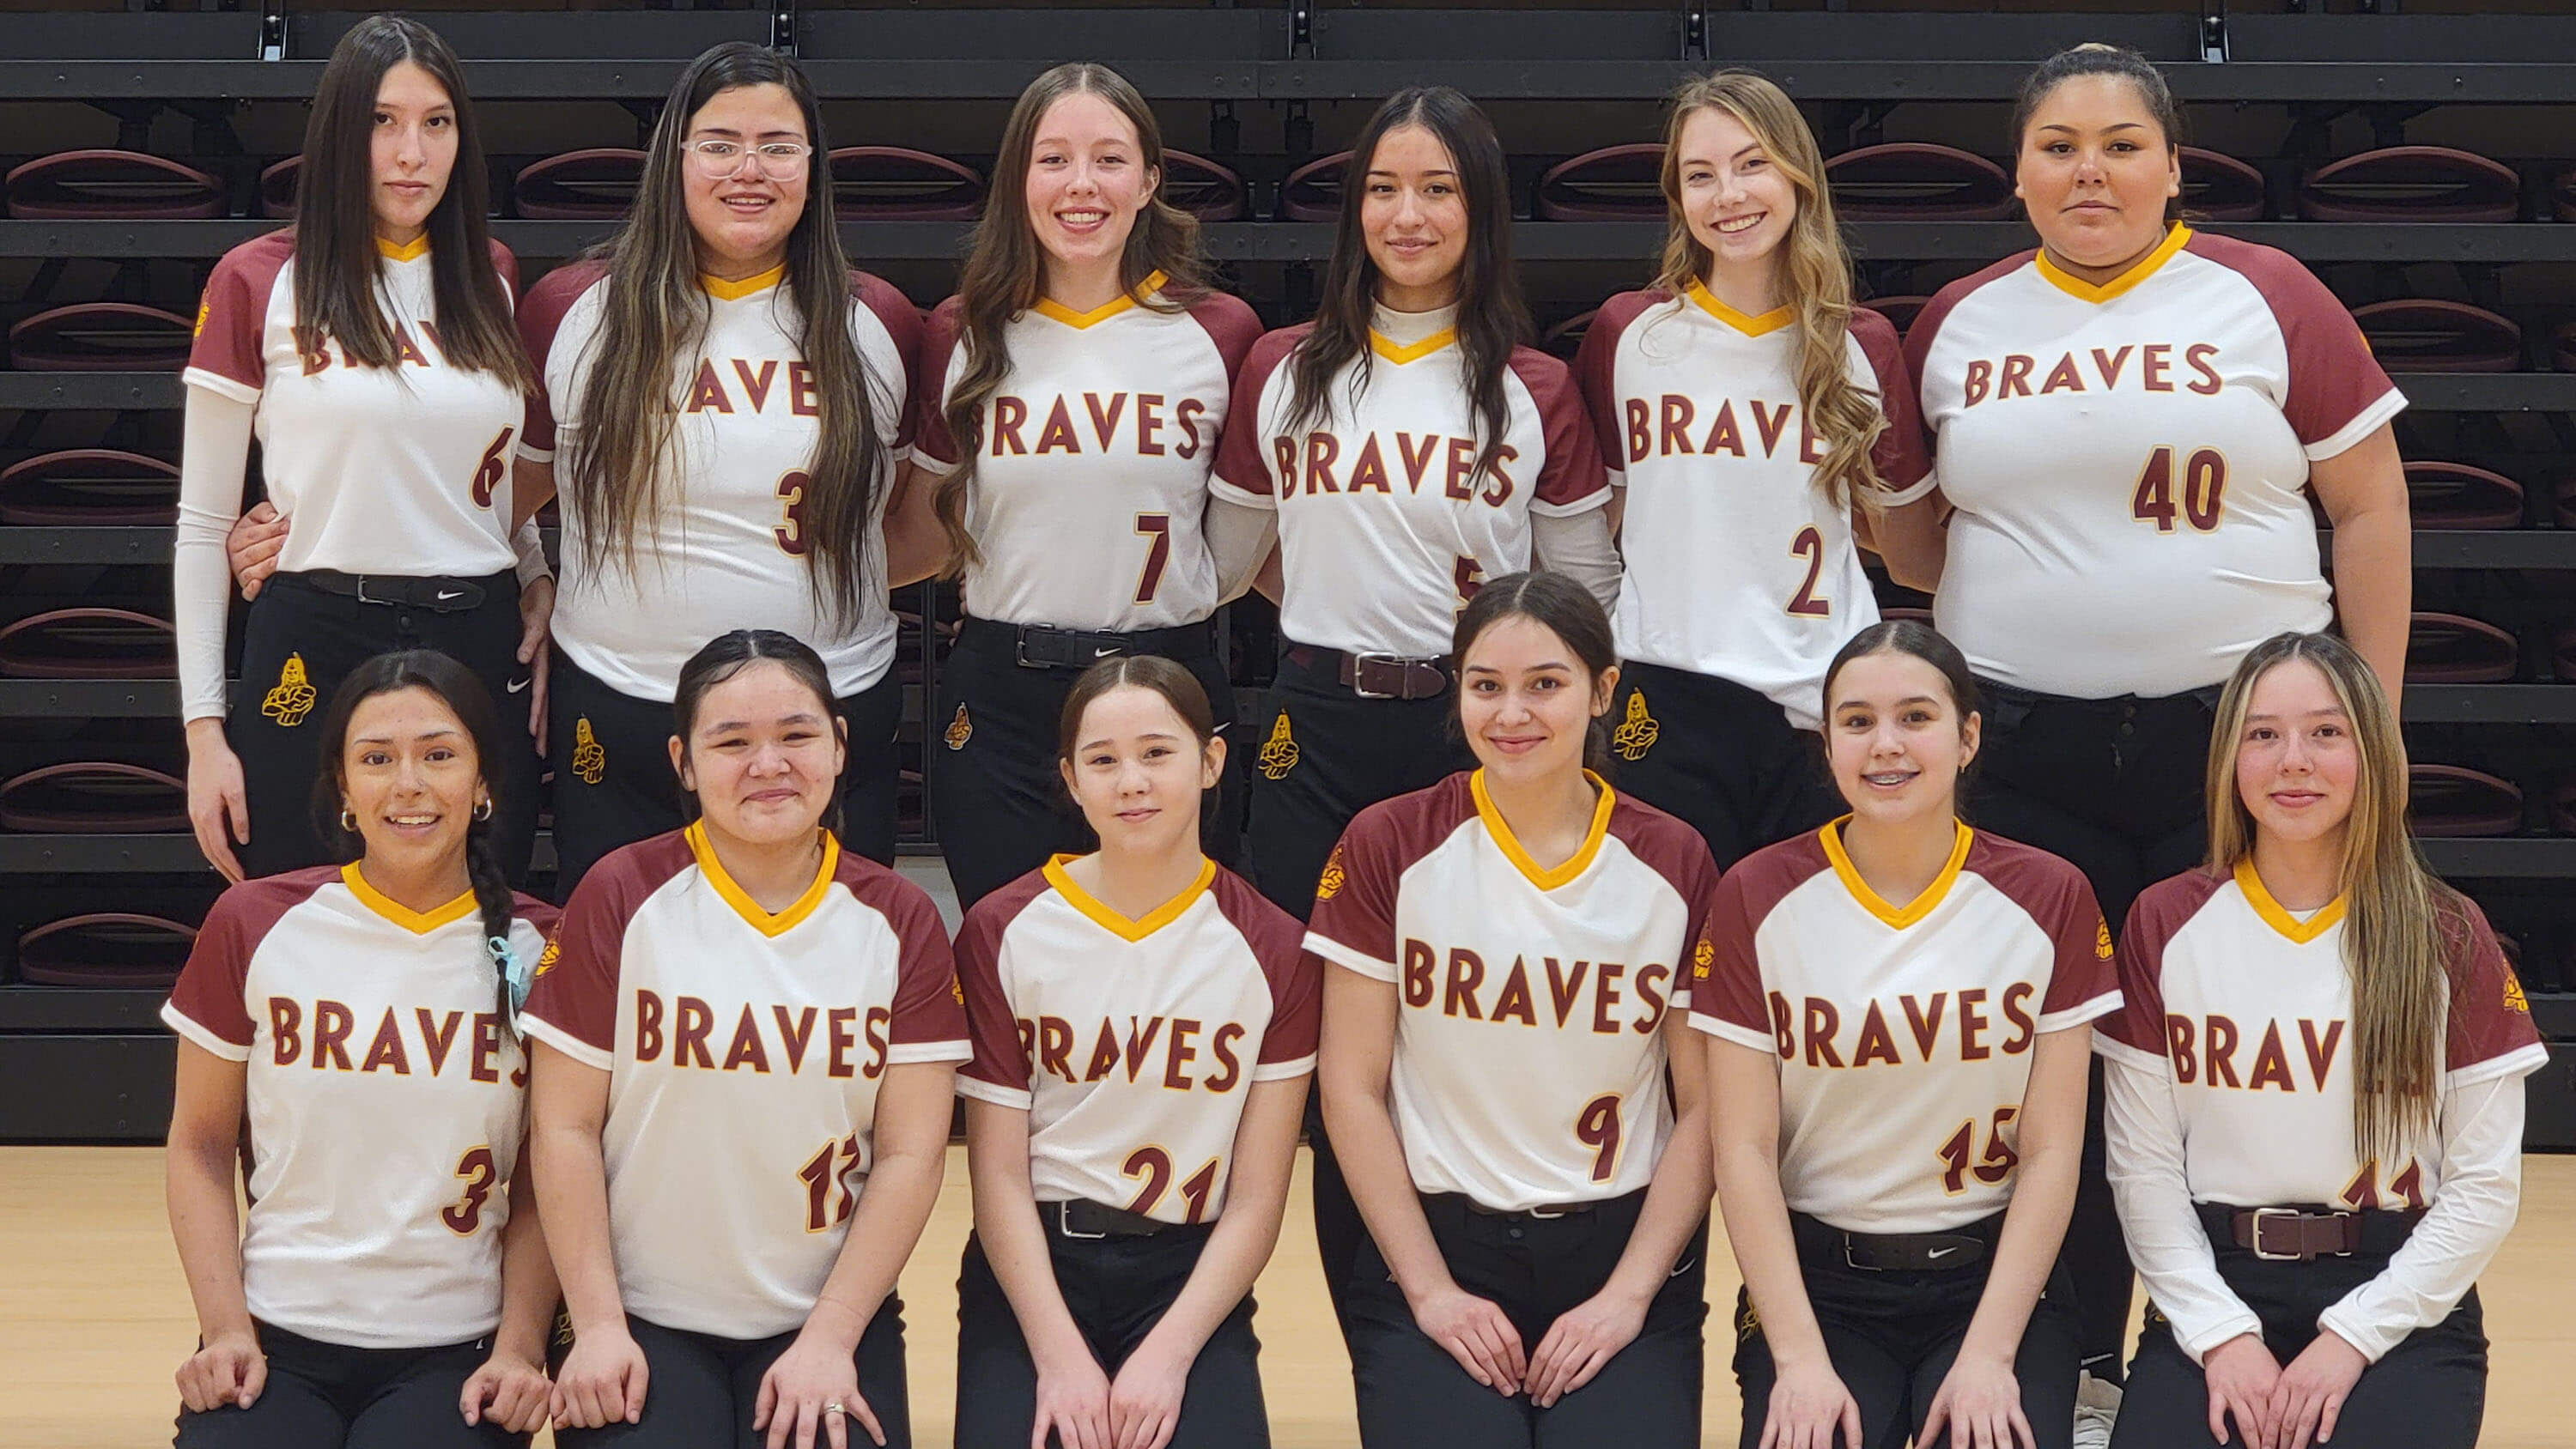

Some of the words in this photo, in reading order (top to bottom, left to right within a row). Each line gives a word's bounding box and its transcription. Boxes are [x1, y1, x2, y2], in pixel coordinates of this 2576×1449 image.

[685, 355, 821, 418] AVE
[1963, 343, 2225, 410] BRAVES
[468, 422, 516, 512] 6
[1273, 430, 1520, 508] BRAVES
[1625, 393, 1826, 466] BRAVE
[2129, 443, 2230, 536] 40
[1132, 511, 1171, 606] 7
[1783, 522, 1831, 620] 2
[1403, 937, 1671, 1036] BRAVES
[1768, 980, 2036, 1069] BRAVES
[635, 988, 891, 1081] BRAVES
[2166, 1013, 2347, 1094] BRAV
[1572, 1090, 1625, 1186] 9
[1935, 1104, 2021, 1197] 15
[440, 1143, 498, 1239] 3
[1118, 1143, 1223, 1225] 21
